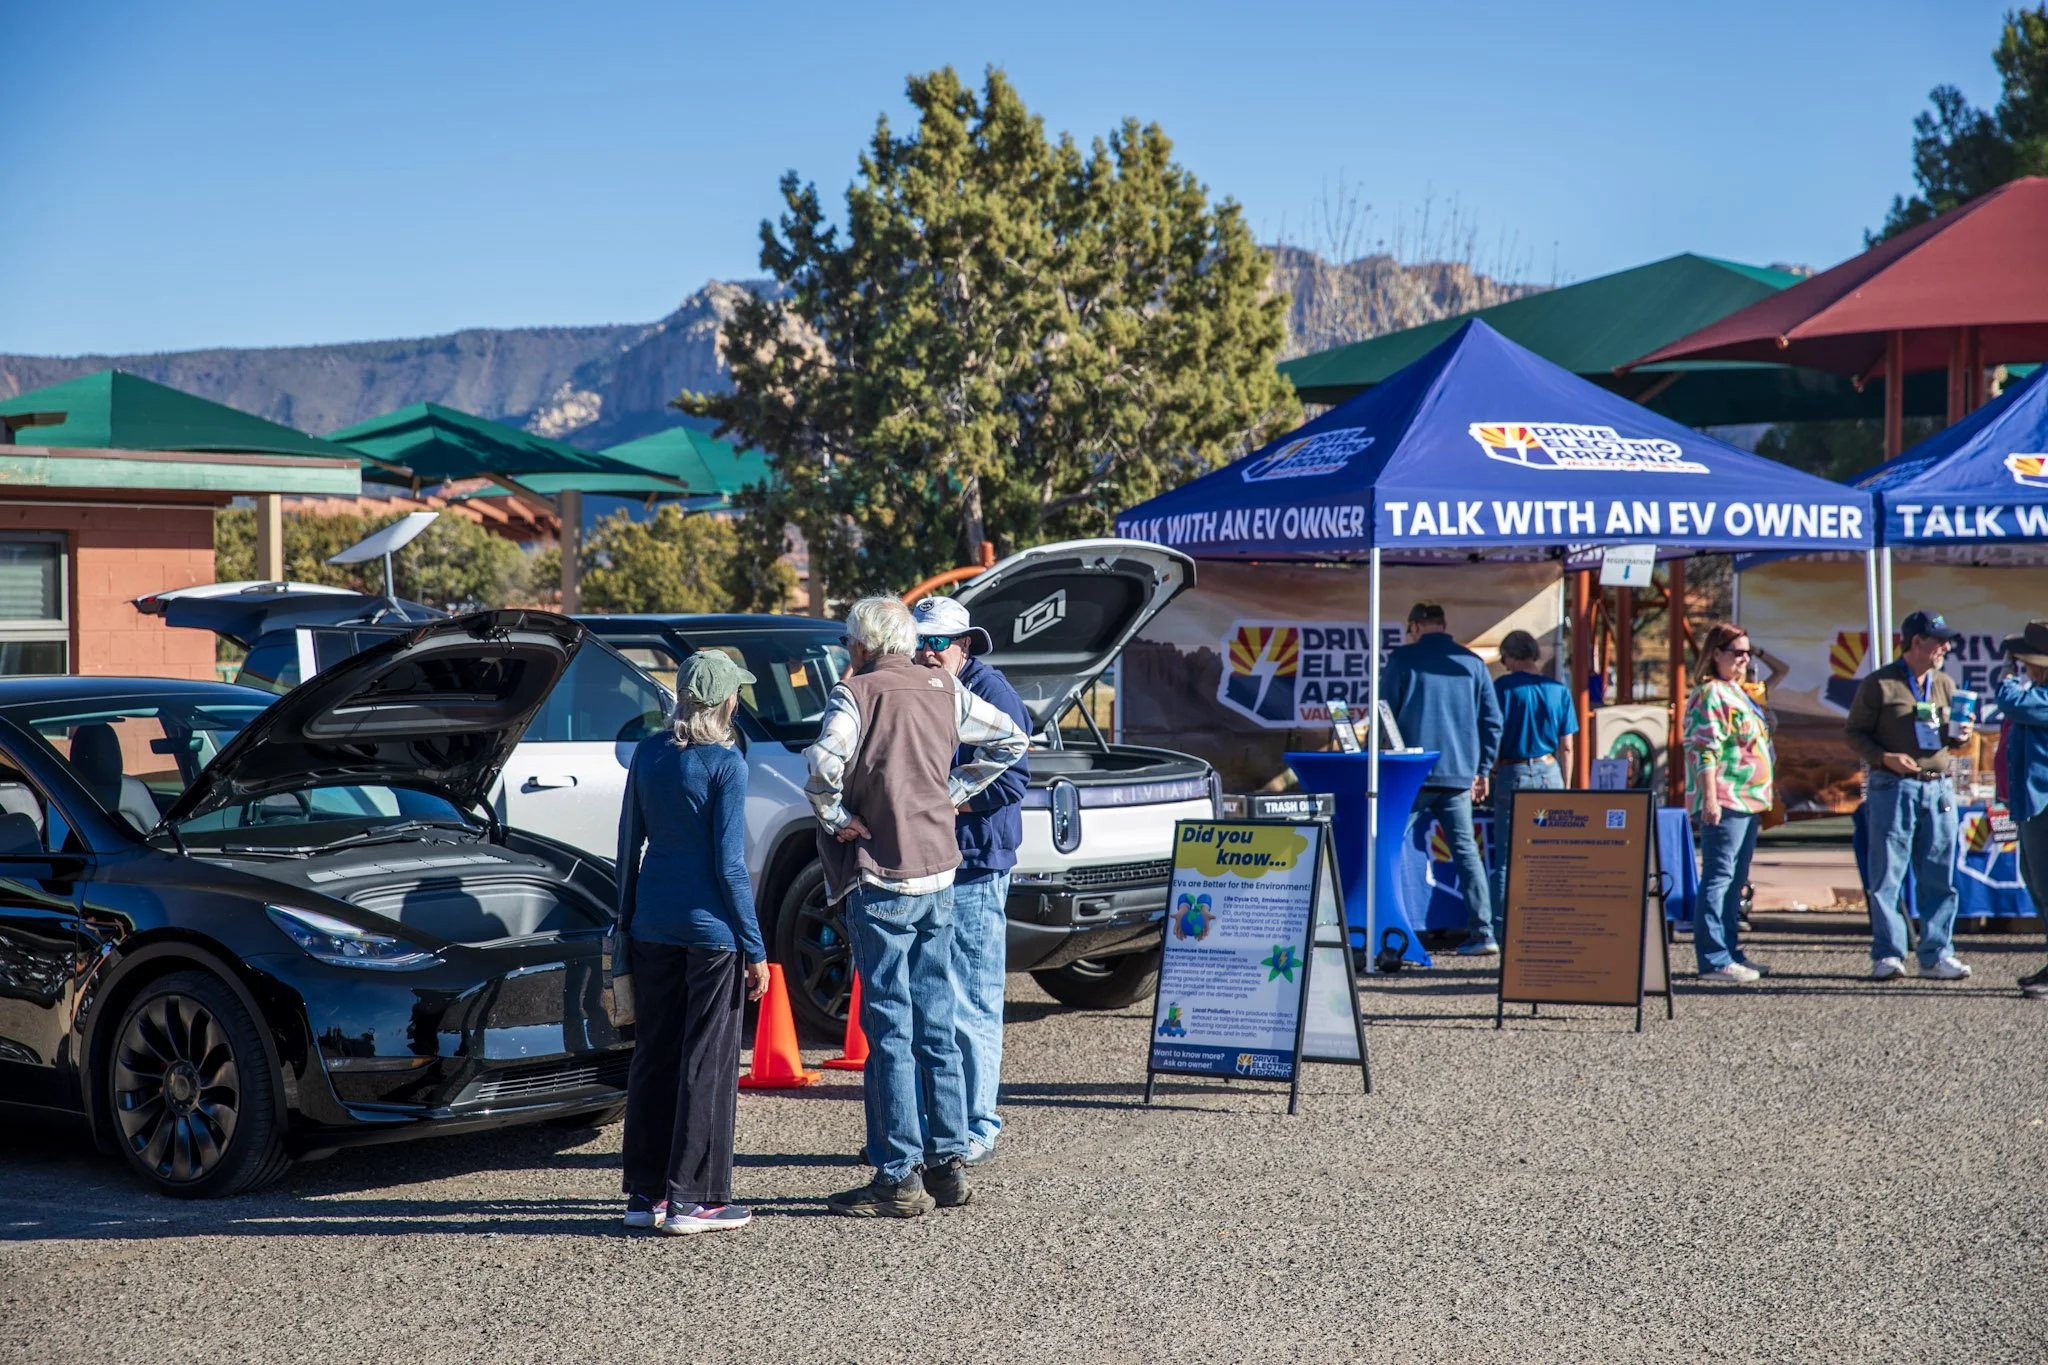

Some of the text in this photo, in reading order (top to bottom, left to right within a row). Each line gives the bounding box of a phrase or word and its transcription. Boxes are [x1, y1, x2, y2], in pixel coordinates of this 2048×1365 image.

[1531, 427, 1616, 442] DRIVE
[1541, 439, 1677, 459] ELECTRIC
[1556, 450, 1680, 464] ARIZONA
[1166, 511, 1217, 545] WITH
[1219, 509, 1250, 541] AN
[1253, 508, 1280, 539] EV
[1282, 505, 1365, 539] OWNER
[1384, 500, 1863, 538] TALK WITH AN EV OWNER
[1896, 505, 2006, 538] TALK
[1300, 707, 1368, 720] VALEY
[1112, 781, 1194, 803] RIVIAN
[1264, 801, 1298, 813] TRASH
[1182, 826, 1254, 848] Did you
[1216, 849, 1286, 867] know...
[1173, 879, 1187, 887] EVs
[1203, 880, 1226, 888] Better
[1228, 880, 1239, 888] for
[1240, 880, 1255, 889] the
[1256, 881, 1310, 891] Environment!
[1153, 1049, 1173, 1057] Want
[1182, 1050, 1201, 1058] know
[1202, 1052, 1225, 1060] more?
[1252, 1054, 1279, 1063] DRIVE
[1187, 1061, 1213, 1069] owner!
[1251, 1062, 1292, 1072] ELECTRIC
